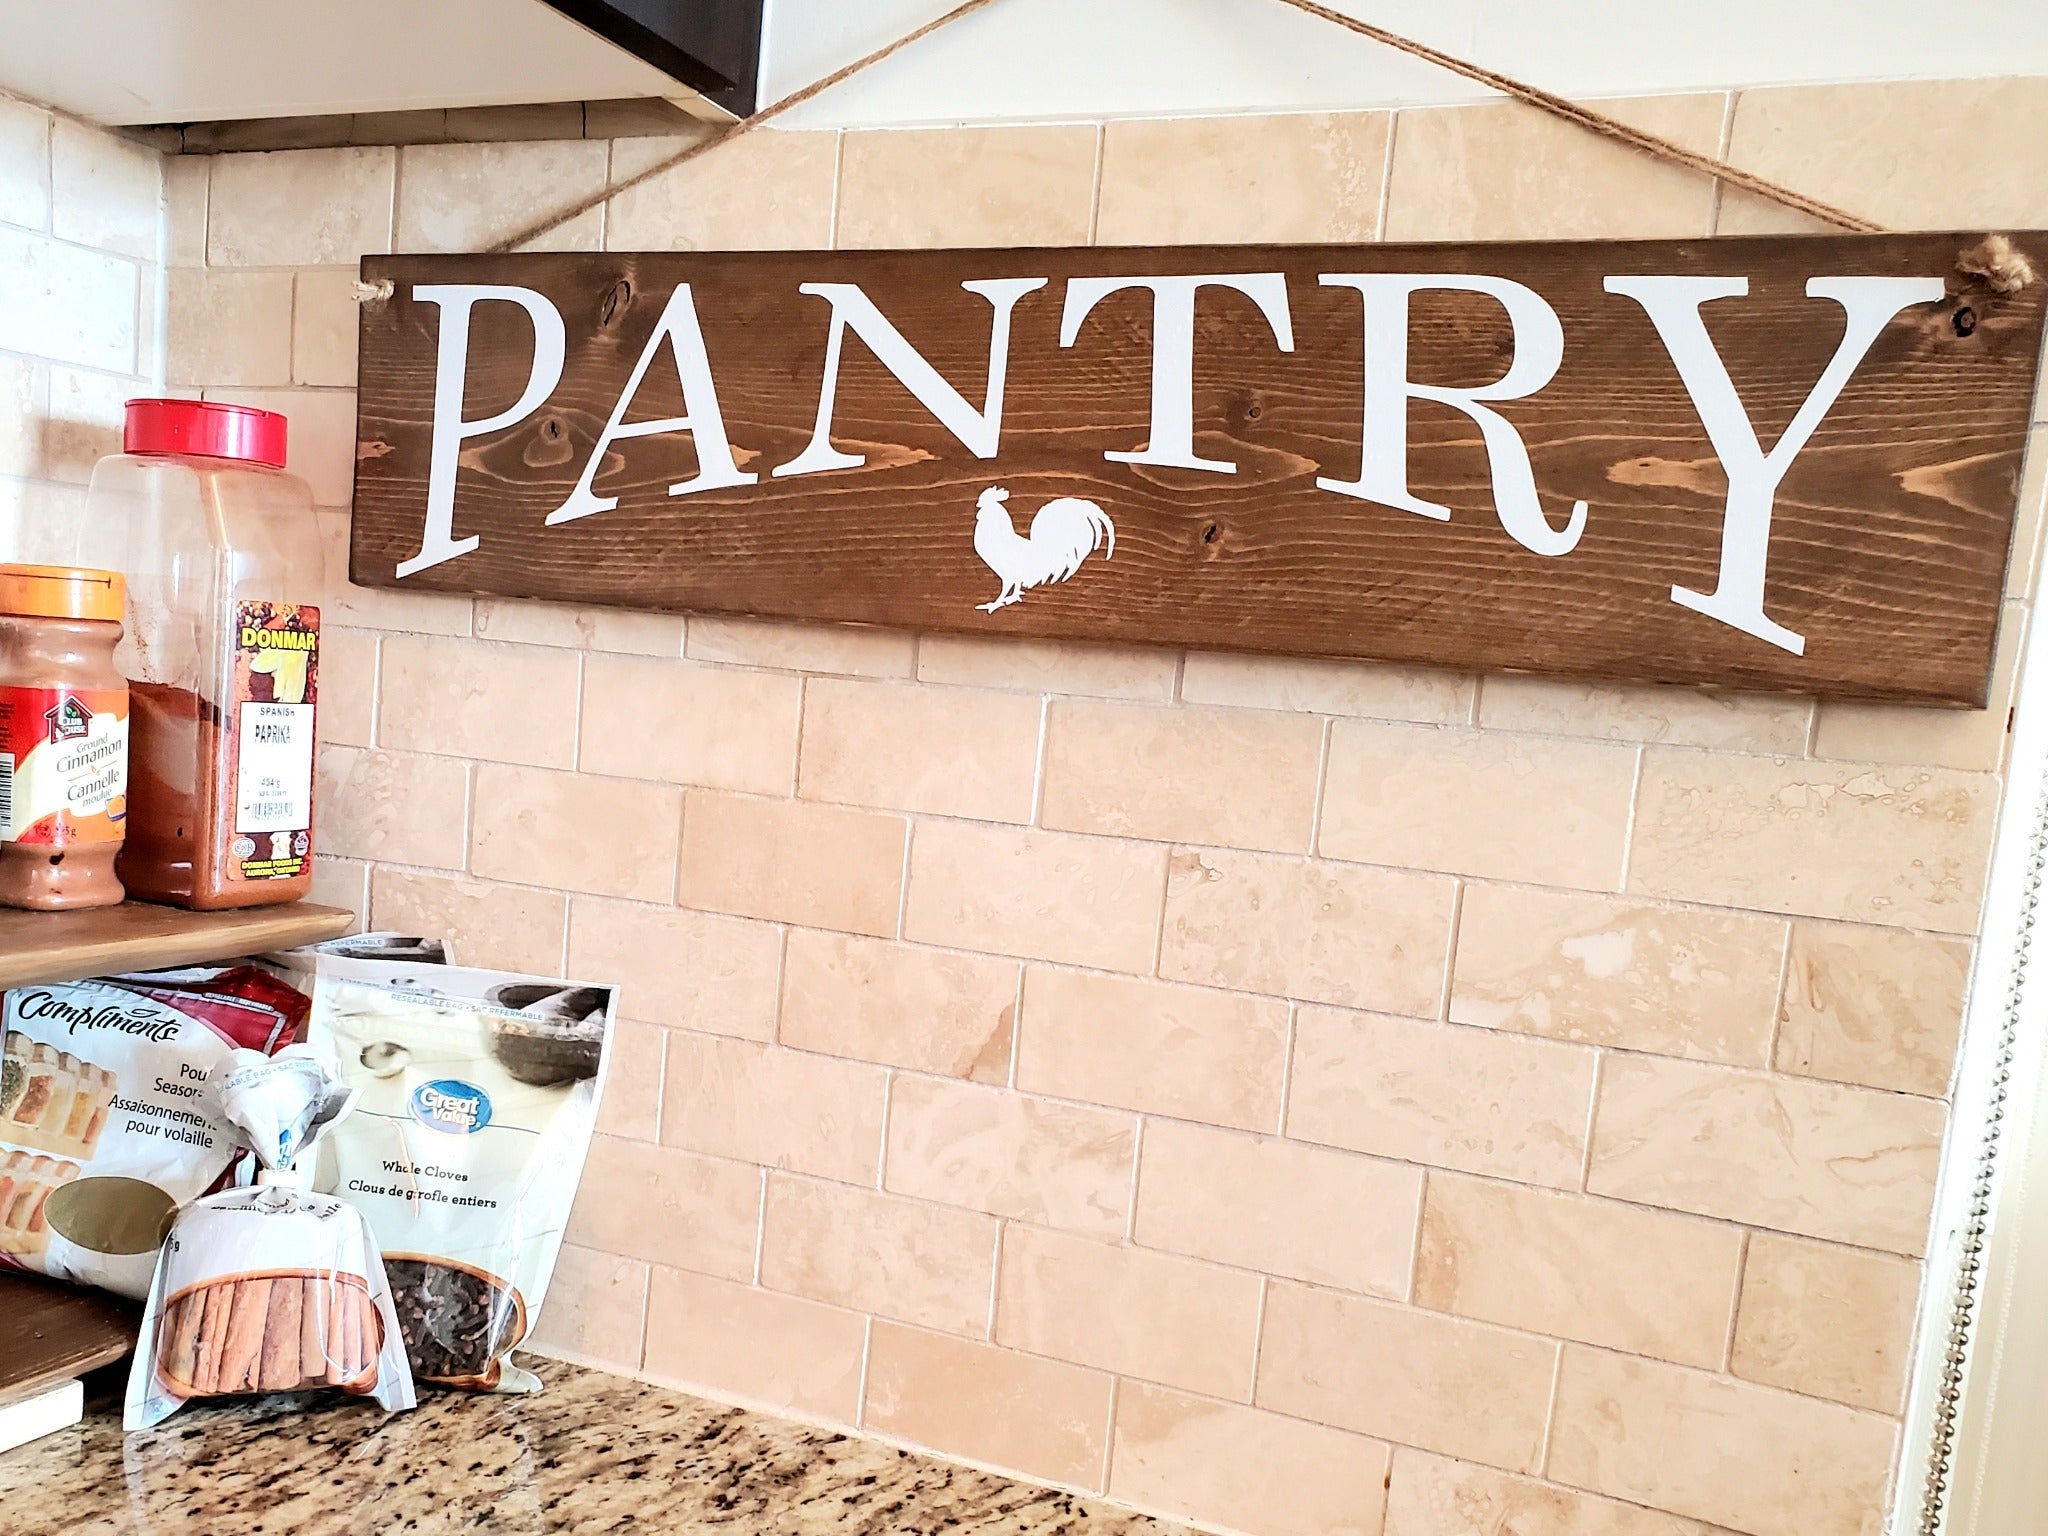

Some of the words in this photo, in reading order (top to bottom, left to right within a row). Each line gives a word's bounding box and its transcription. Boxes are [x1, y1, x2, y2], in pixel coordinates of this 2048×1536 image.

[396, 271, 1946, 657] PANTRY
[241, 627, 316, 651] DONMAR
[76, 732, 108, 754] Ground
[254, 724, 291, 744] PAPRIKA
[56, 739, 122, 773] Cinnamon
[67, 768, 120, 802] Cannelle
[82, 787, 112, 808] moulue
[391, 993, 443, 1009] RESEALABLE
[18, 991, 182, 1043] Compliments
[420, 1087, 480, 1115] Great
[432, 1105, 478, 1126] Value
[125, 1118, 161, 1138] pour
[164, 1127, 213, 1149] volaille
[382, 1160, 422, 1175] Whole
[424, 1166, 469, 1182] Cloves
[348, 1179, 385, 1195] Clous
[388, 1184, 404, 1198] de
[452, 1195, 498, 1209] entiers
